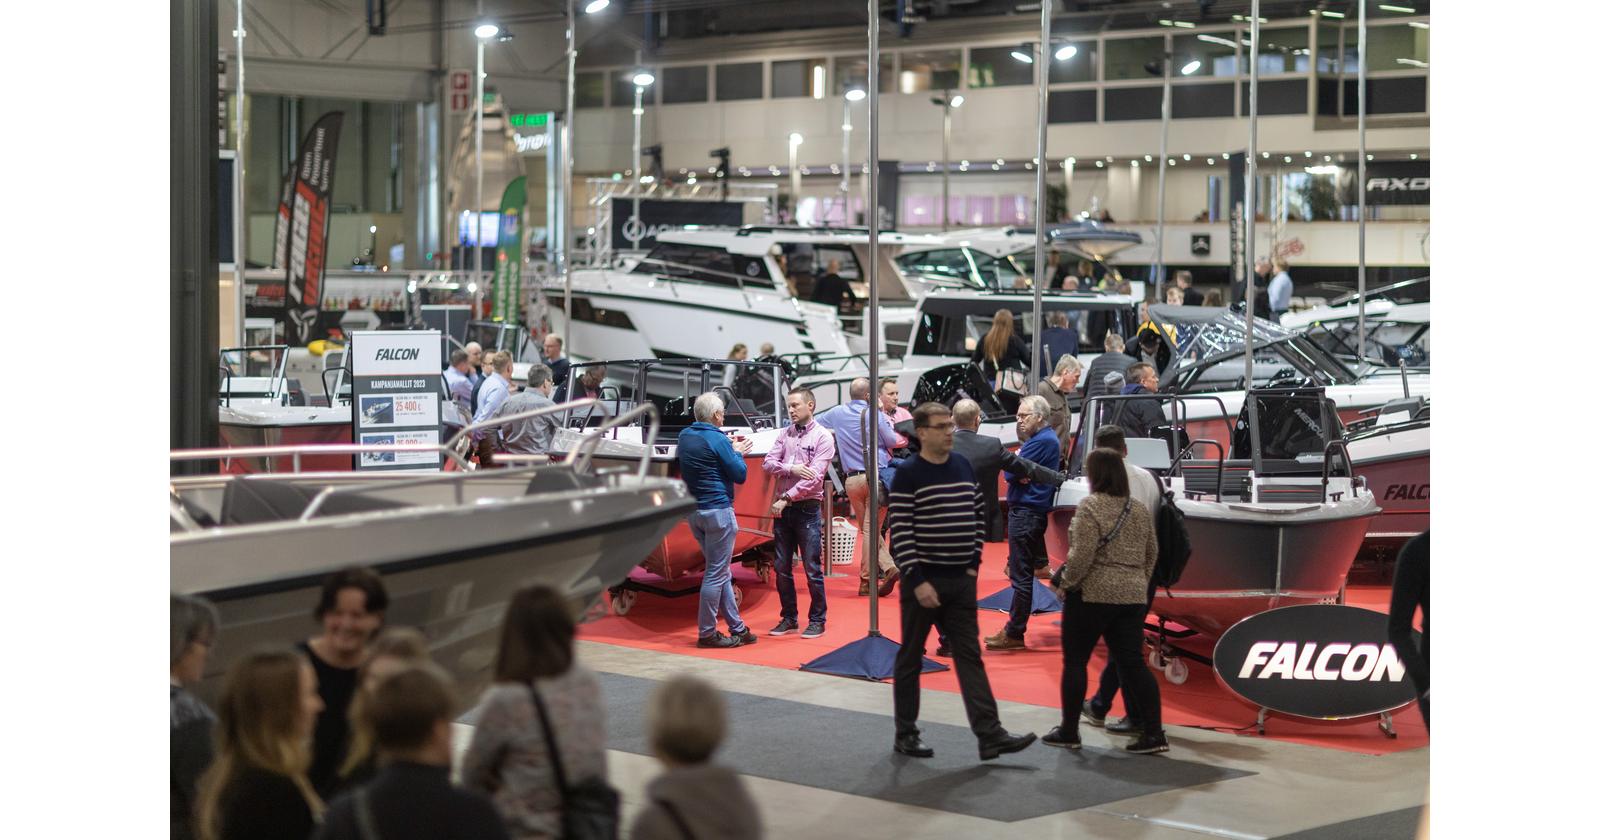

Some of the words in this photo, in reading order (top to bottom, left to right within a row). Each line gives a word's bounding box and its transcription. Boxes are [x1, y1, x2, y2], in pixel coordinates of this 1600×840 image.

[375, 348, 420, 361] FALCON
[370, 379, 412, 389] KAMPANJAMALLIT
[413, 379, 425, 388] 2023
[395, 401, 403, 411] 25
[404, 400, 417, 411] 400
[1384, 484, 1430, 500] FALC
[1238, 642, 1406, 682] FALCON
